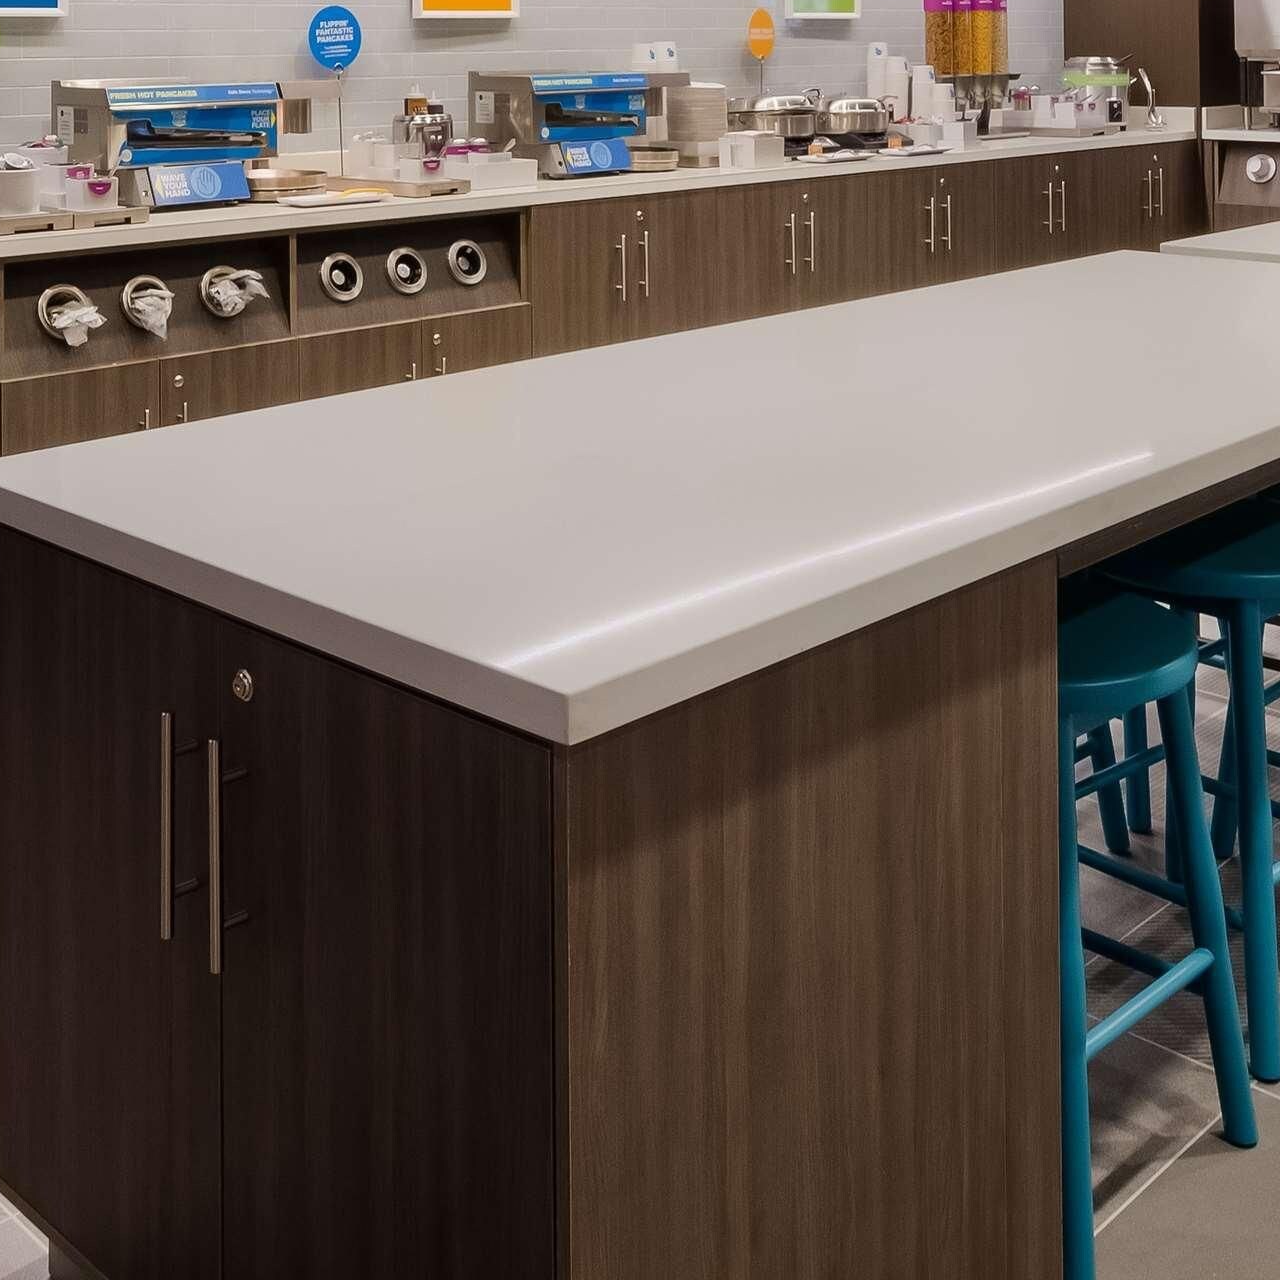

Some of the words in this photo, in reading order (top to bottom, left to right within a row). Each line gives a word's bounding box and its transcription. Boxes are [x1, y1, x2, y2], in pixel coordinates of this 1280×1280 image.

[316, 27, 354, 36] FANTASTIC
[316, 35, 354, 43] PANCAKES
[160, 173, 186, 182] WAVE
[164, 181, 188, 190] YOUR
[165, 188, 190, 198] HAND
